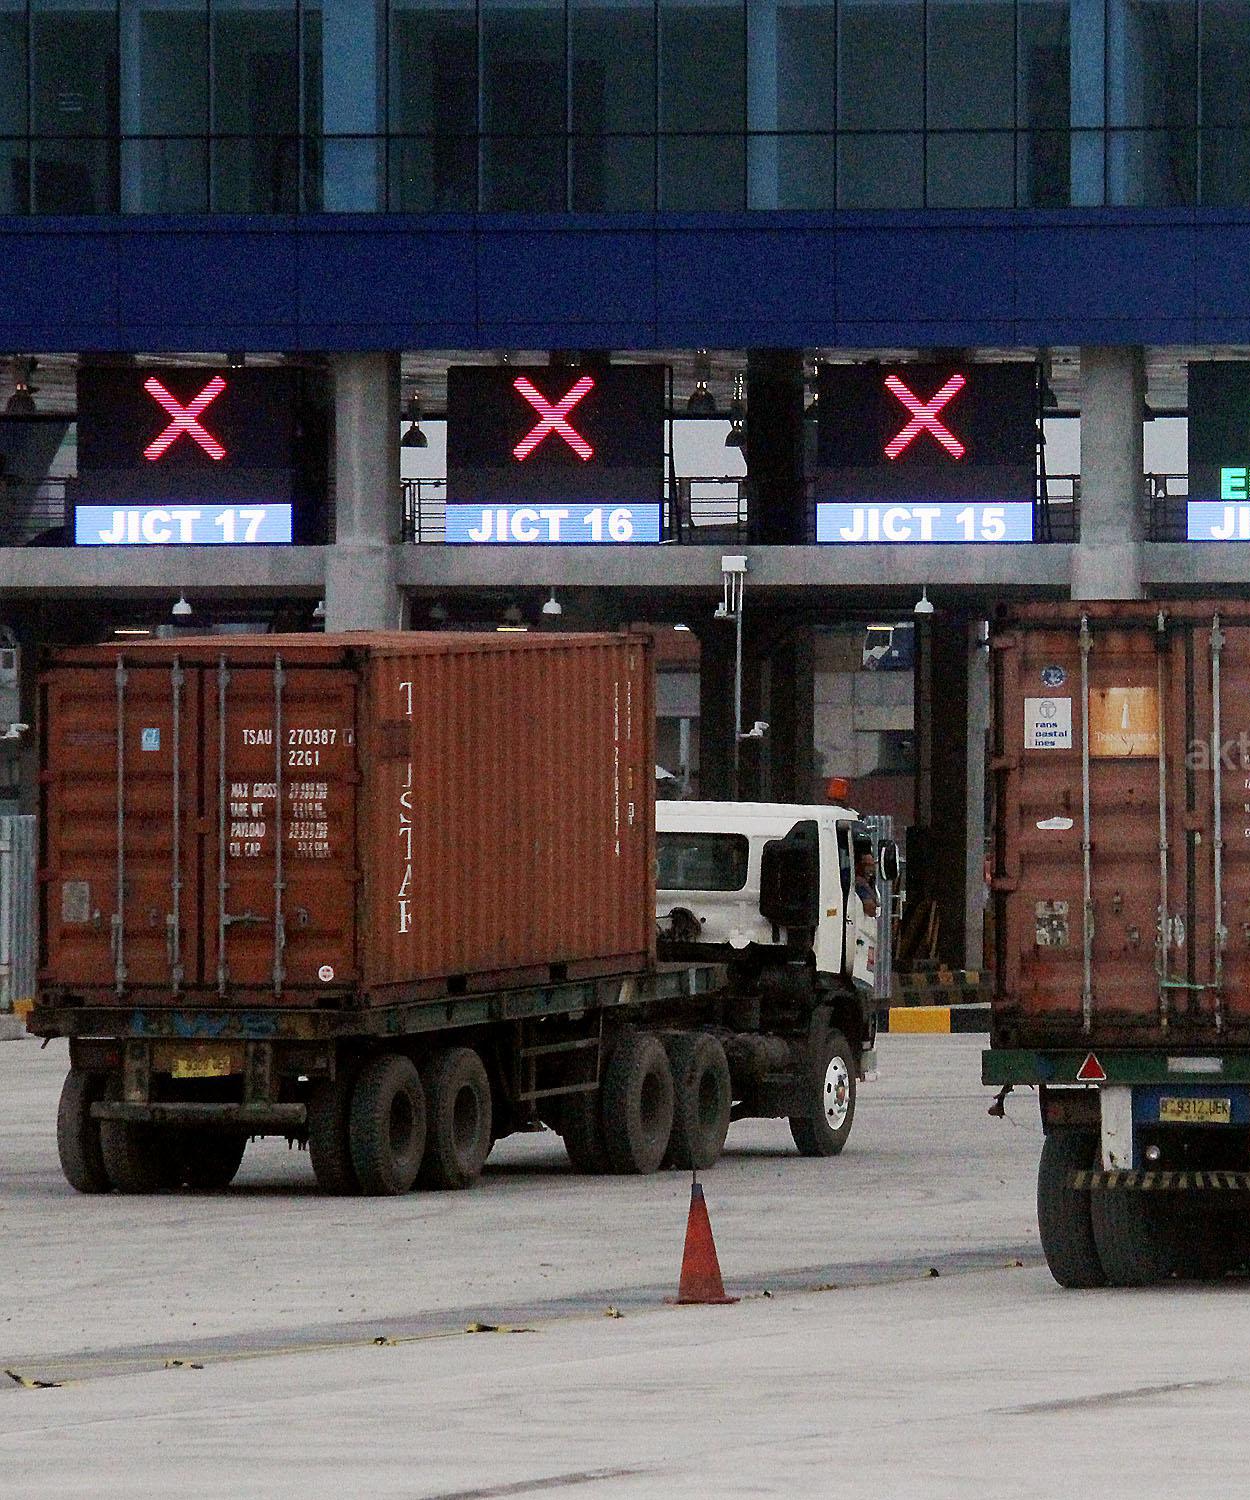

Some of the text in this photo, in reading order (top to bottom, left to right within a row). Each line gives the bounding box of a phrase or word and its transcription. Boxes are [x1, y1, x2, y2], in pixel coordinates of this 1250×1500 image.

[98, 509, 266, 543] JICT 17
[468, 508, 634, 542] JICT 16
[840, 507, 1006, 541] JICT 15
[242, 729, 273, 745] TSAU
[288, 728, 336, 745] 270387
[230, 822, 266, 838] PAYLOAD
